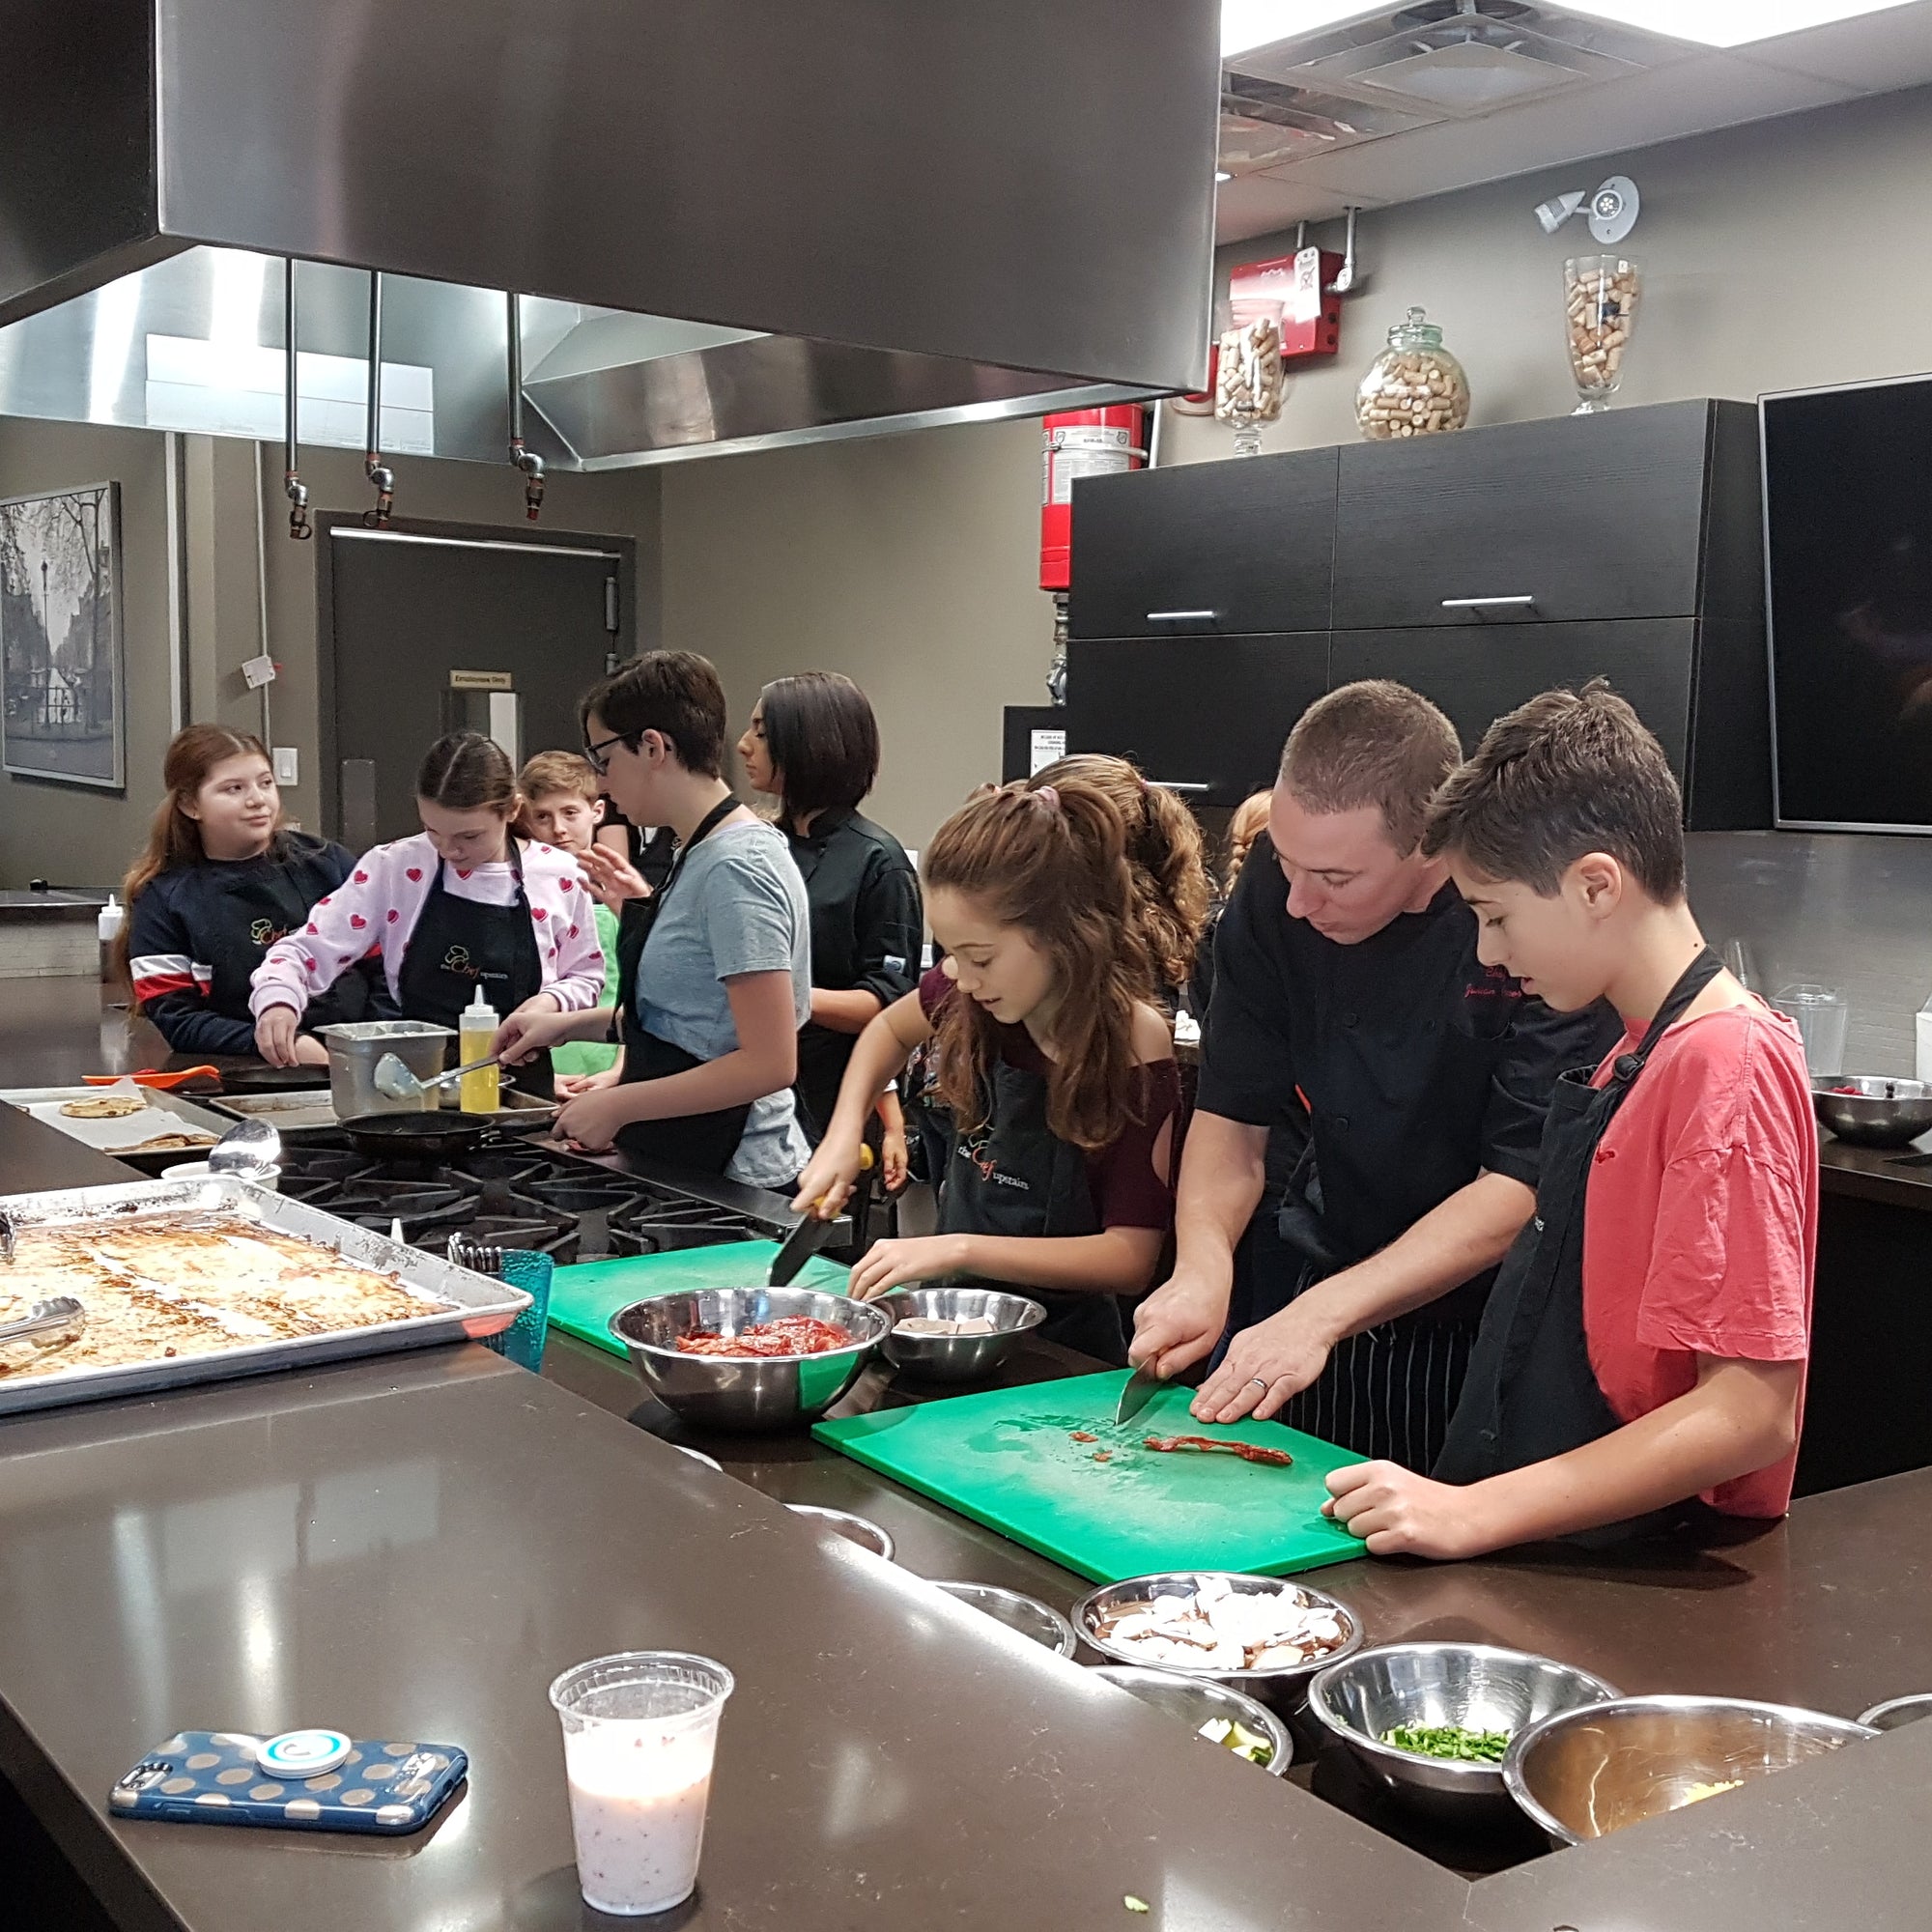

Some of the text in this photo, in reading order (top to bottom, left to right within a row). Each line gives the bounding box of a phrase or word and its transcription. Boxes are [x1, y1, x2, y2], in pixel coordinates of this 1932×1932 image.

[455, 675, 506, 685] Employees Only
[451, 959, 480, 980] Chef
[957, 1146, 972, 1158] the
